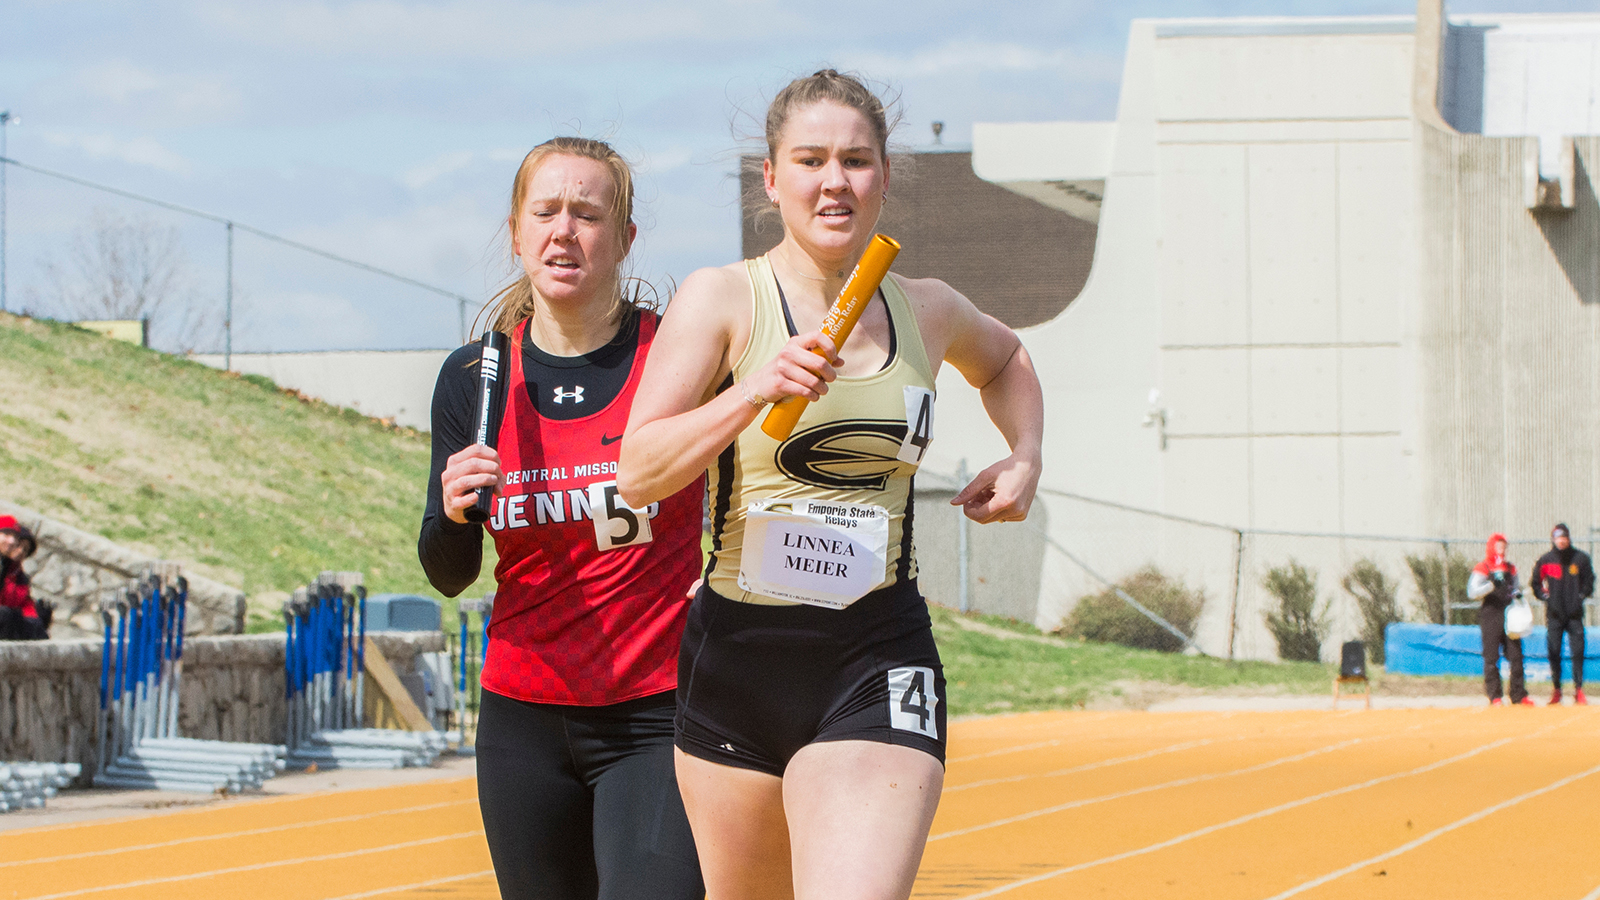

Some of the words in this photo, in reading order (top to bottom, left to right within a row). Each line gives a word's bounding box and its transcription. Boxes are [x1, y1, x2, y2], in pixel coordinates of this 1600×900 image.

[841, 295, 858, 318] Relay
[825, 307, 841, 331] 2019
[910, 393, 930, 461] 4
[506, 467, 568, 485] CENTRAL
[573, 461, 619, 478] MISSO
[603, 485, 639, 546] 5
[807, 503, 847, 517] Emporia
[850, 507, 875, 518] State
[825, 514, 858, 528] Relays
[782, 532, 856, 557] LINNEA
[784, 555, 849, 578] MEIER
[900, 670, 930, 732] 4
